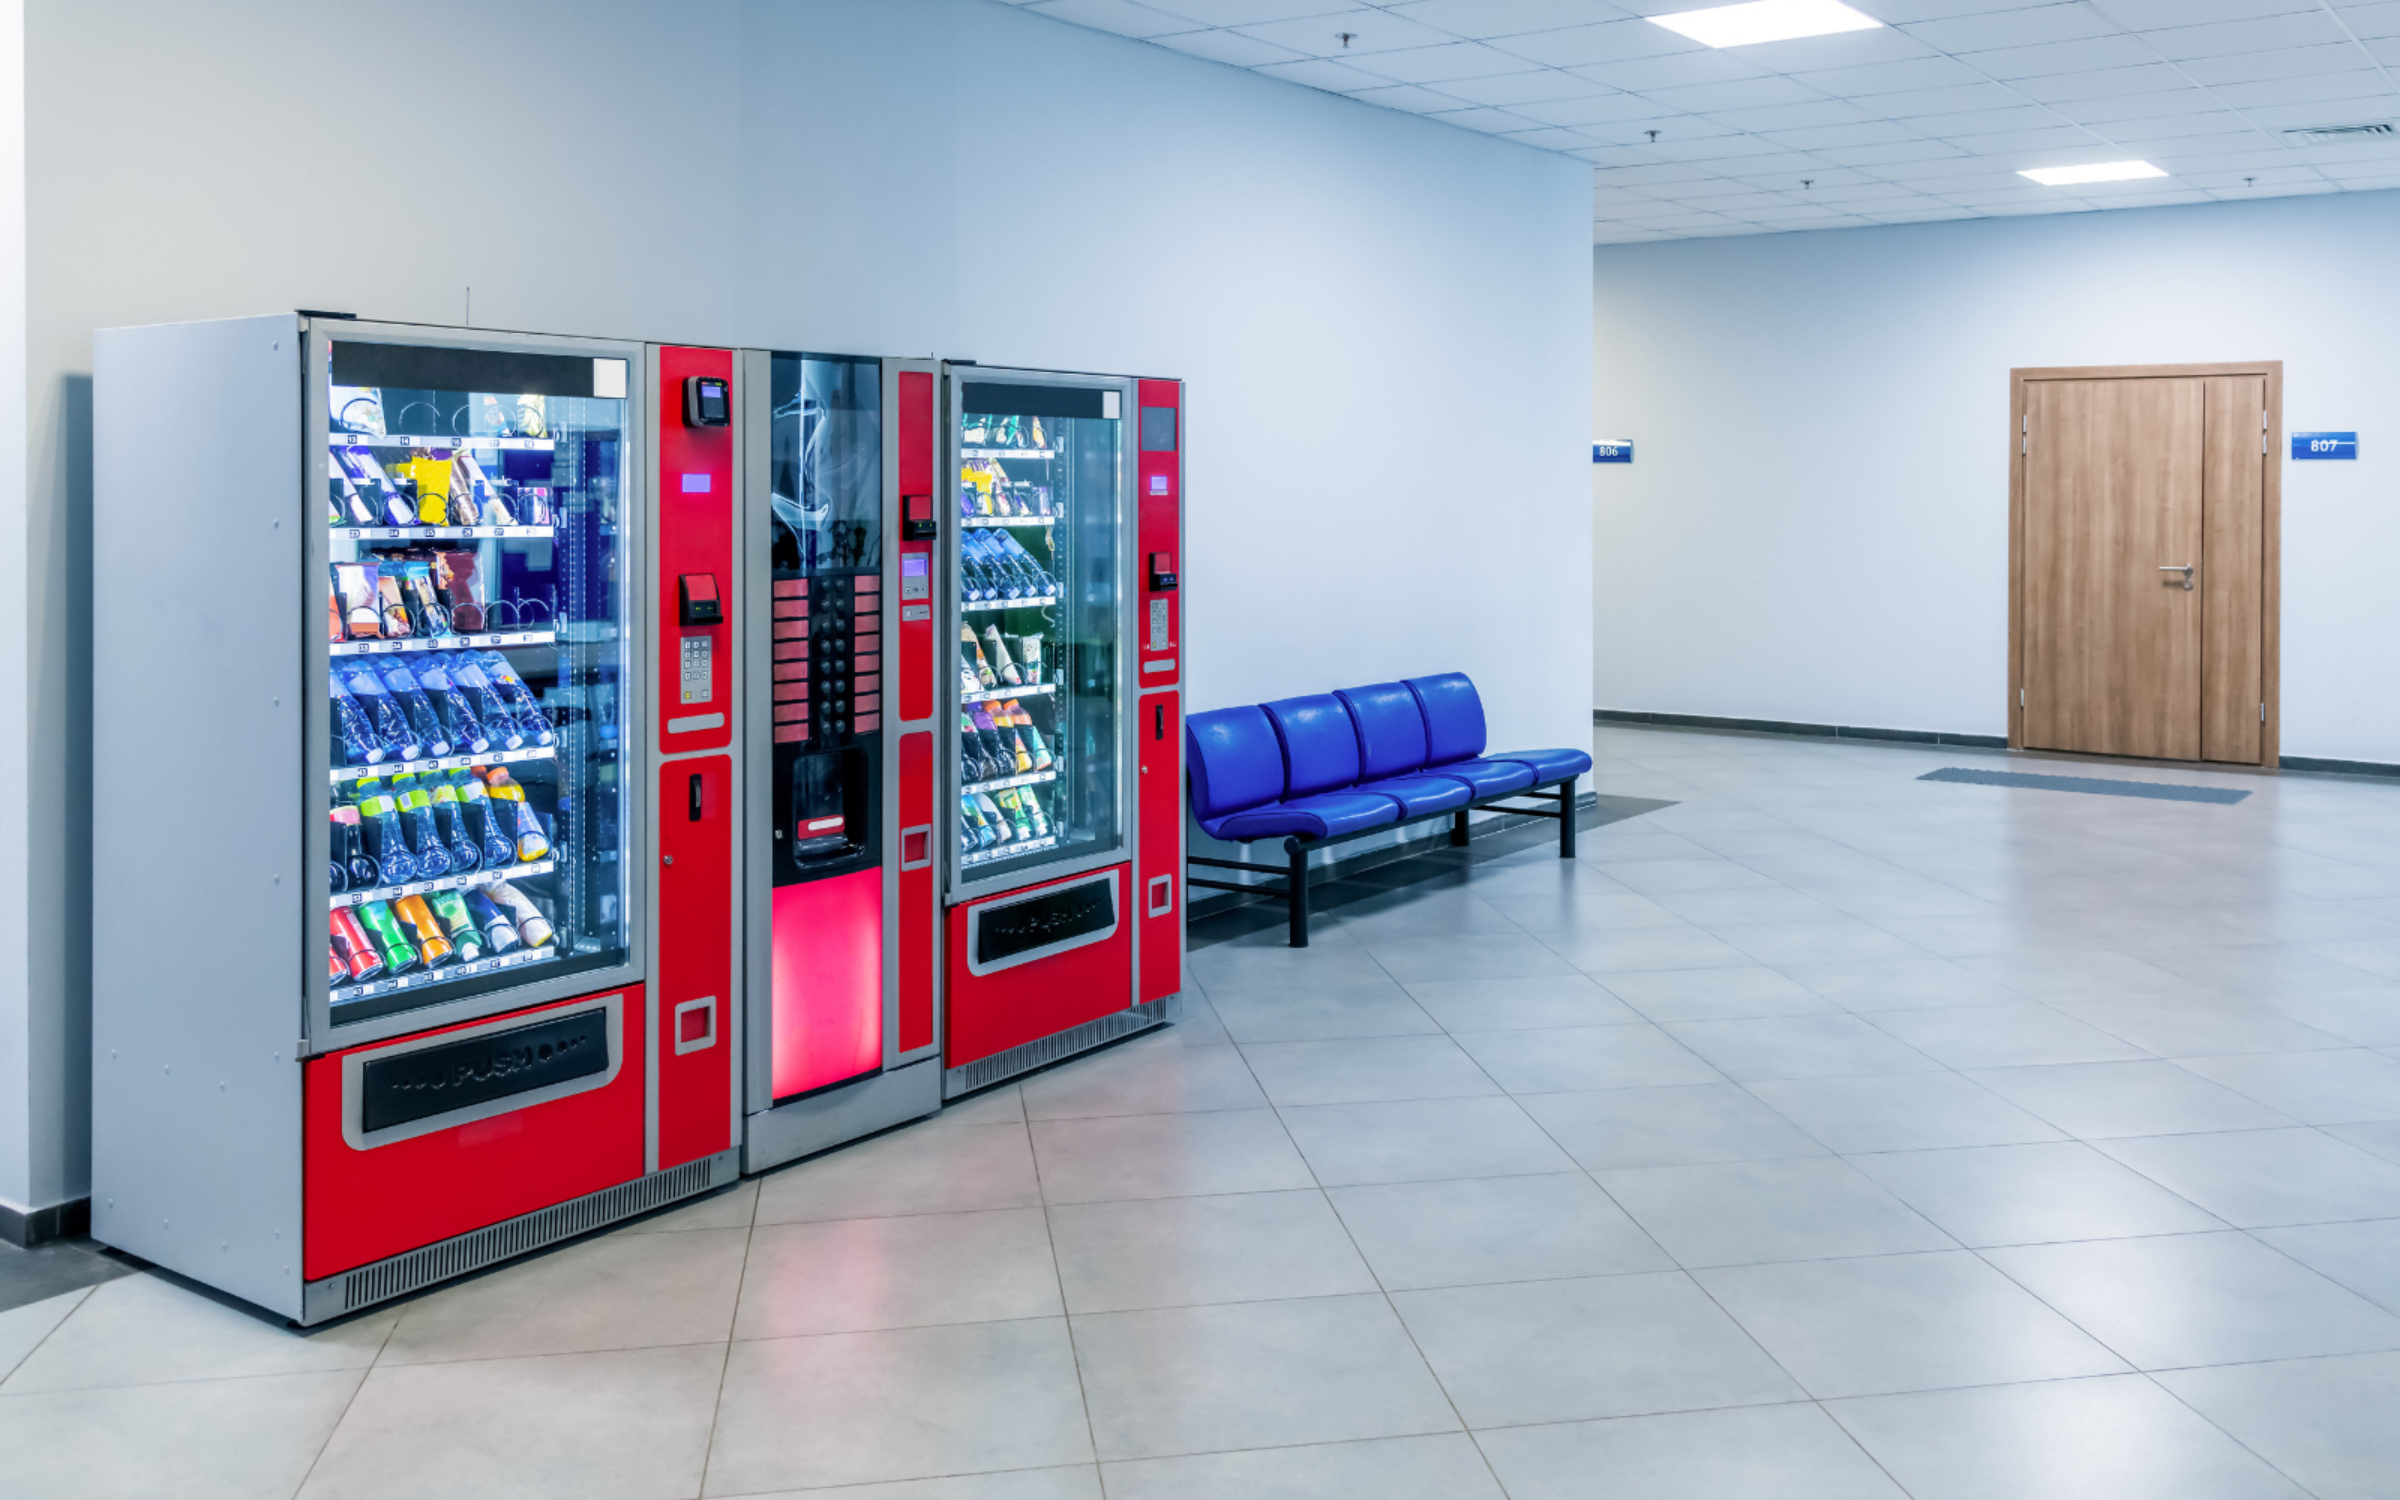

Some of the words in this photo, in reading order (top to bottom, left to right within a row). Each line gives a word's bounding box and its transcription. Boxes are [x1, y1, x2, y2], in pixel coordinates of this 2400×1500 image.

[1599, 446, 1618, 456] 806
[2311, 439, 2338, 452] 807
[454, 1046, 532, 1086] PUSH
